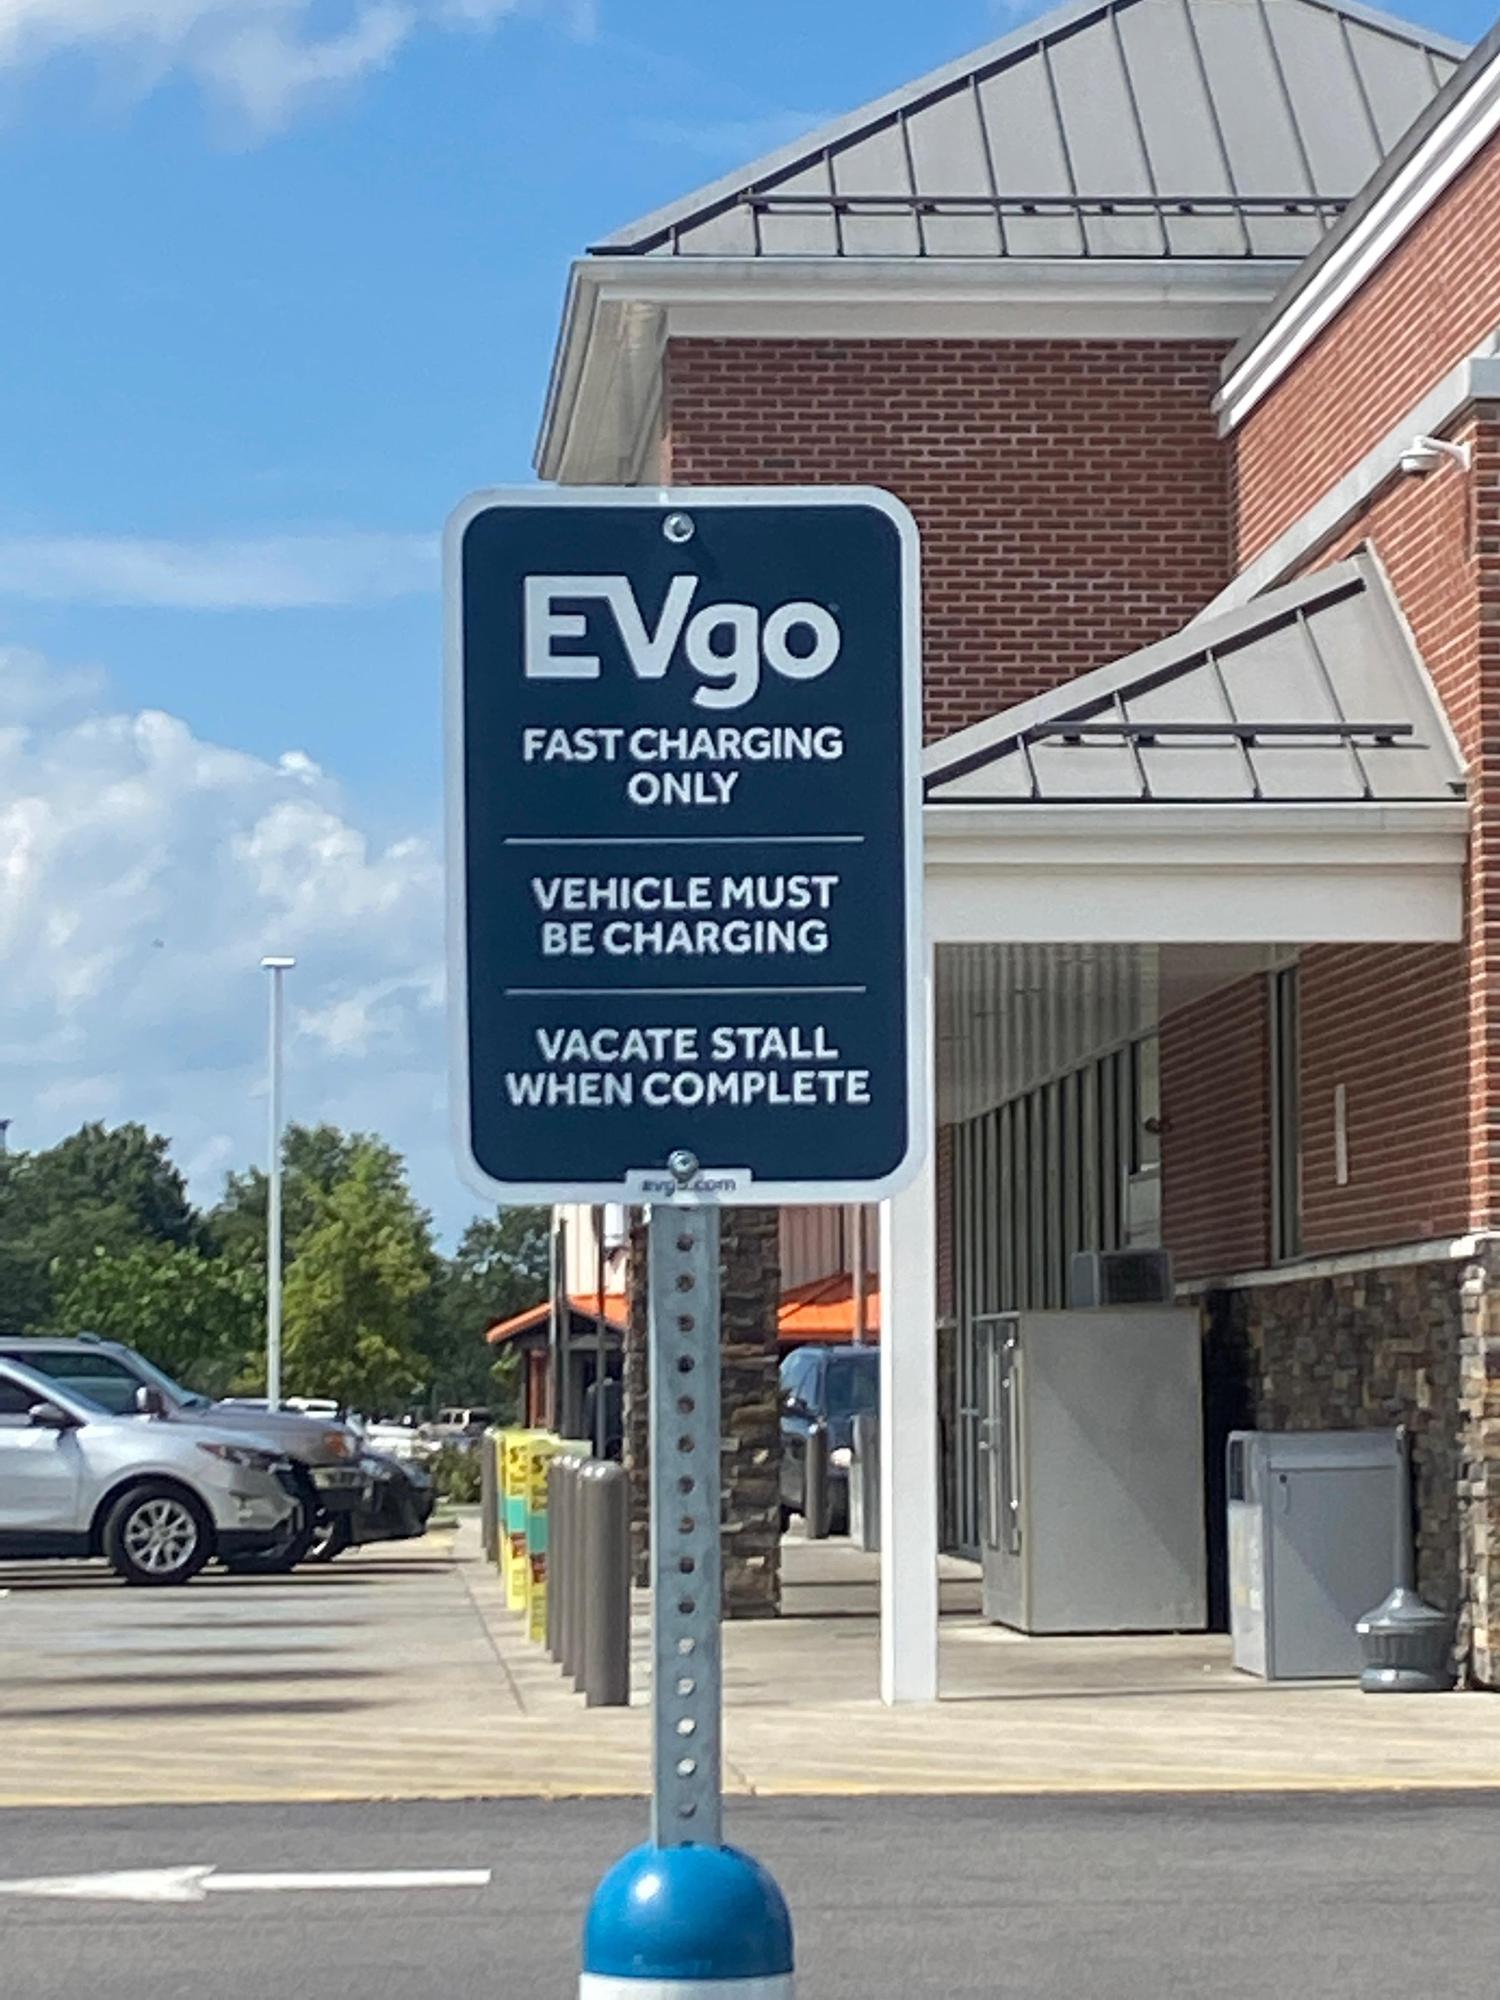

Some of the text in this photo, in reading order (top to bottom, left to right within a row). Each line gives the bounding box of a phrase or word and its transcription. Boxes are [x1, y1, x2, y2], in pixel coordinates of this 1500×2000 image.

[524, 575, 841, 710] EVgo
[523, 726, 843, 762] FAST CHARGING
[627, 771, 739, 805] ONLY
[532, 875, 839, 911] VEHICLE MUST
[542, 919, 829, 955] BE CHARGING
[536, 1025, 839, 1062] VACATE STALL
[505, 1070, 871, 1106] WHEN COMPLETE
